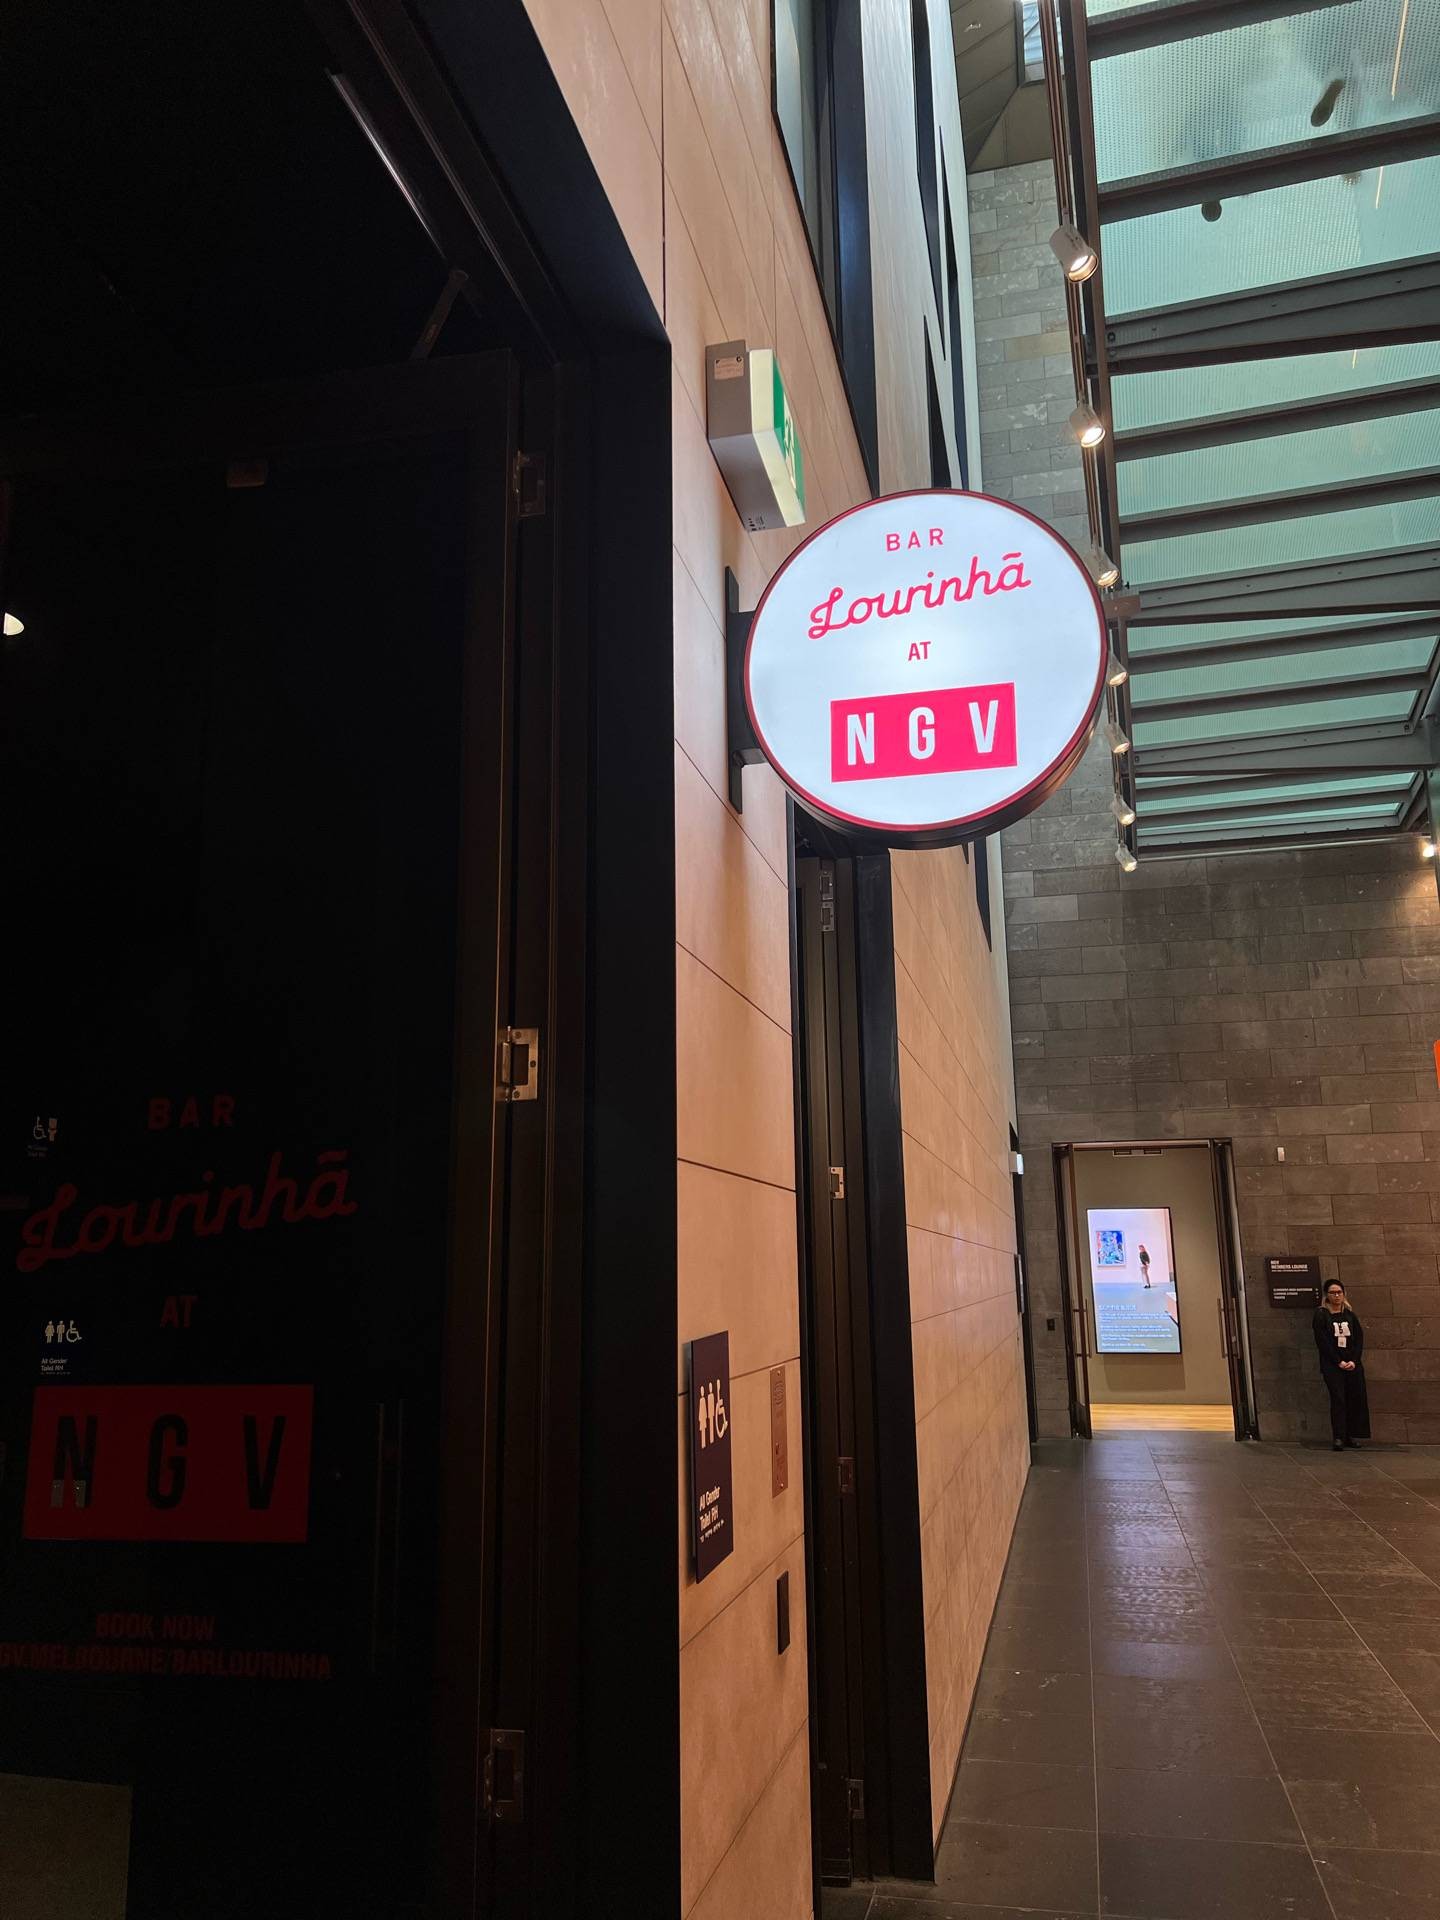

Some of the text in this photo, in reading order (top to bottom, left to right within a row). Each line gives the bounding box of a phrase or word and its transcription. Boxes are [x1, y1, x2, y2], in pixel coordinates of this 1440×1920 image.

[886, 527, 944, 552] BAR
[808, 551, 1031, 640] Lourinhã
[908, 641, 931, 661] AT
[148, 1094, 236, 1131] BAR
[16, 1149, 359, 1272] Lourinhã
[160, 1295, 199, 1328] AT
[706, 1486, 721, 1507] Gender
[699, 1511, 711, 1533] Toilet
[96, 1612, 217, 1642] BOOK NOW
